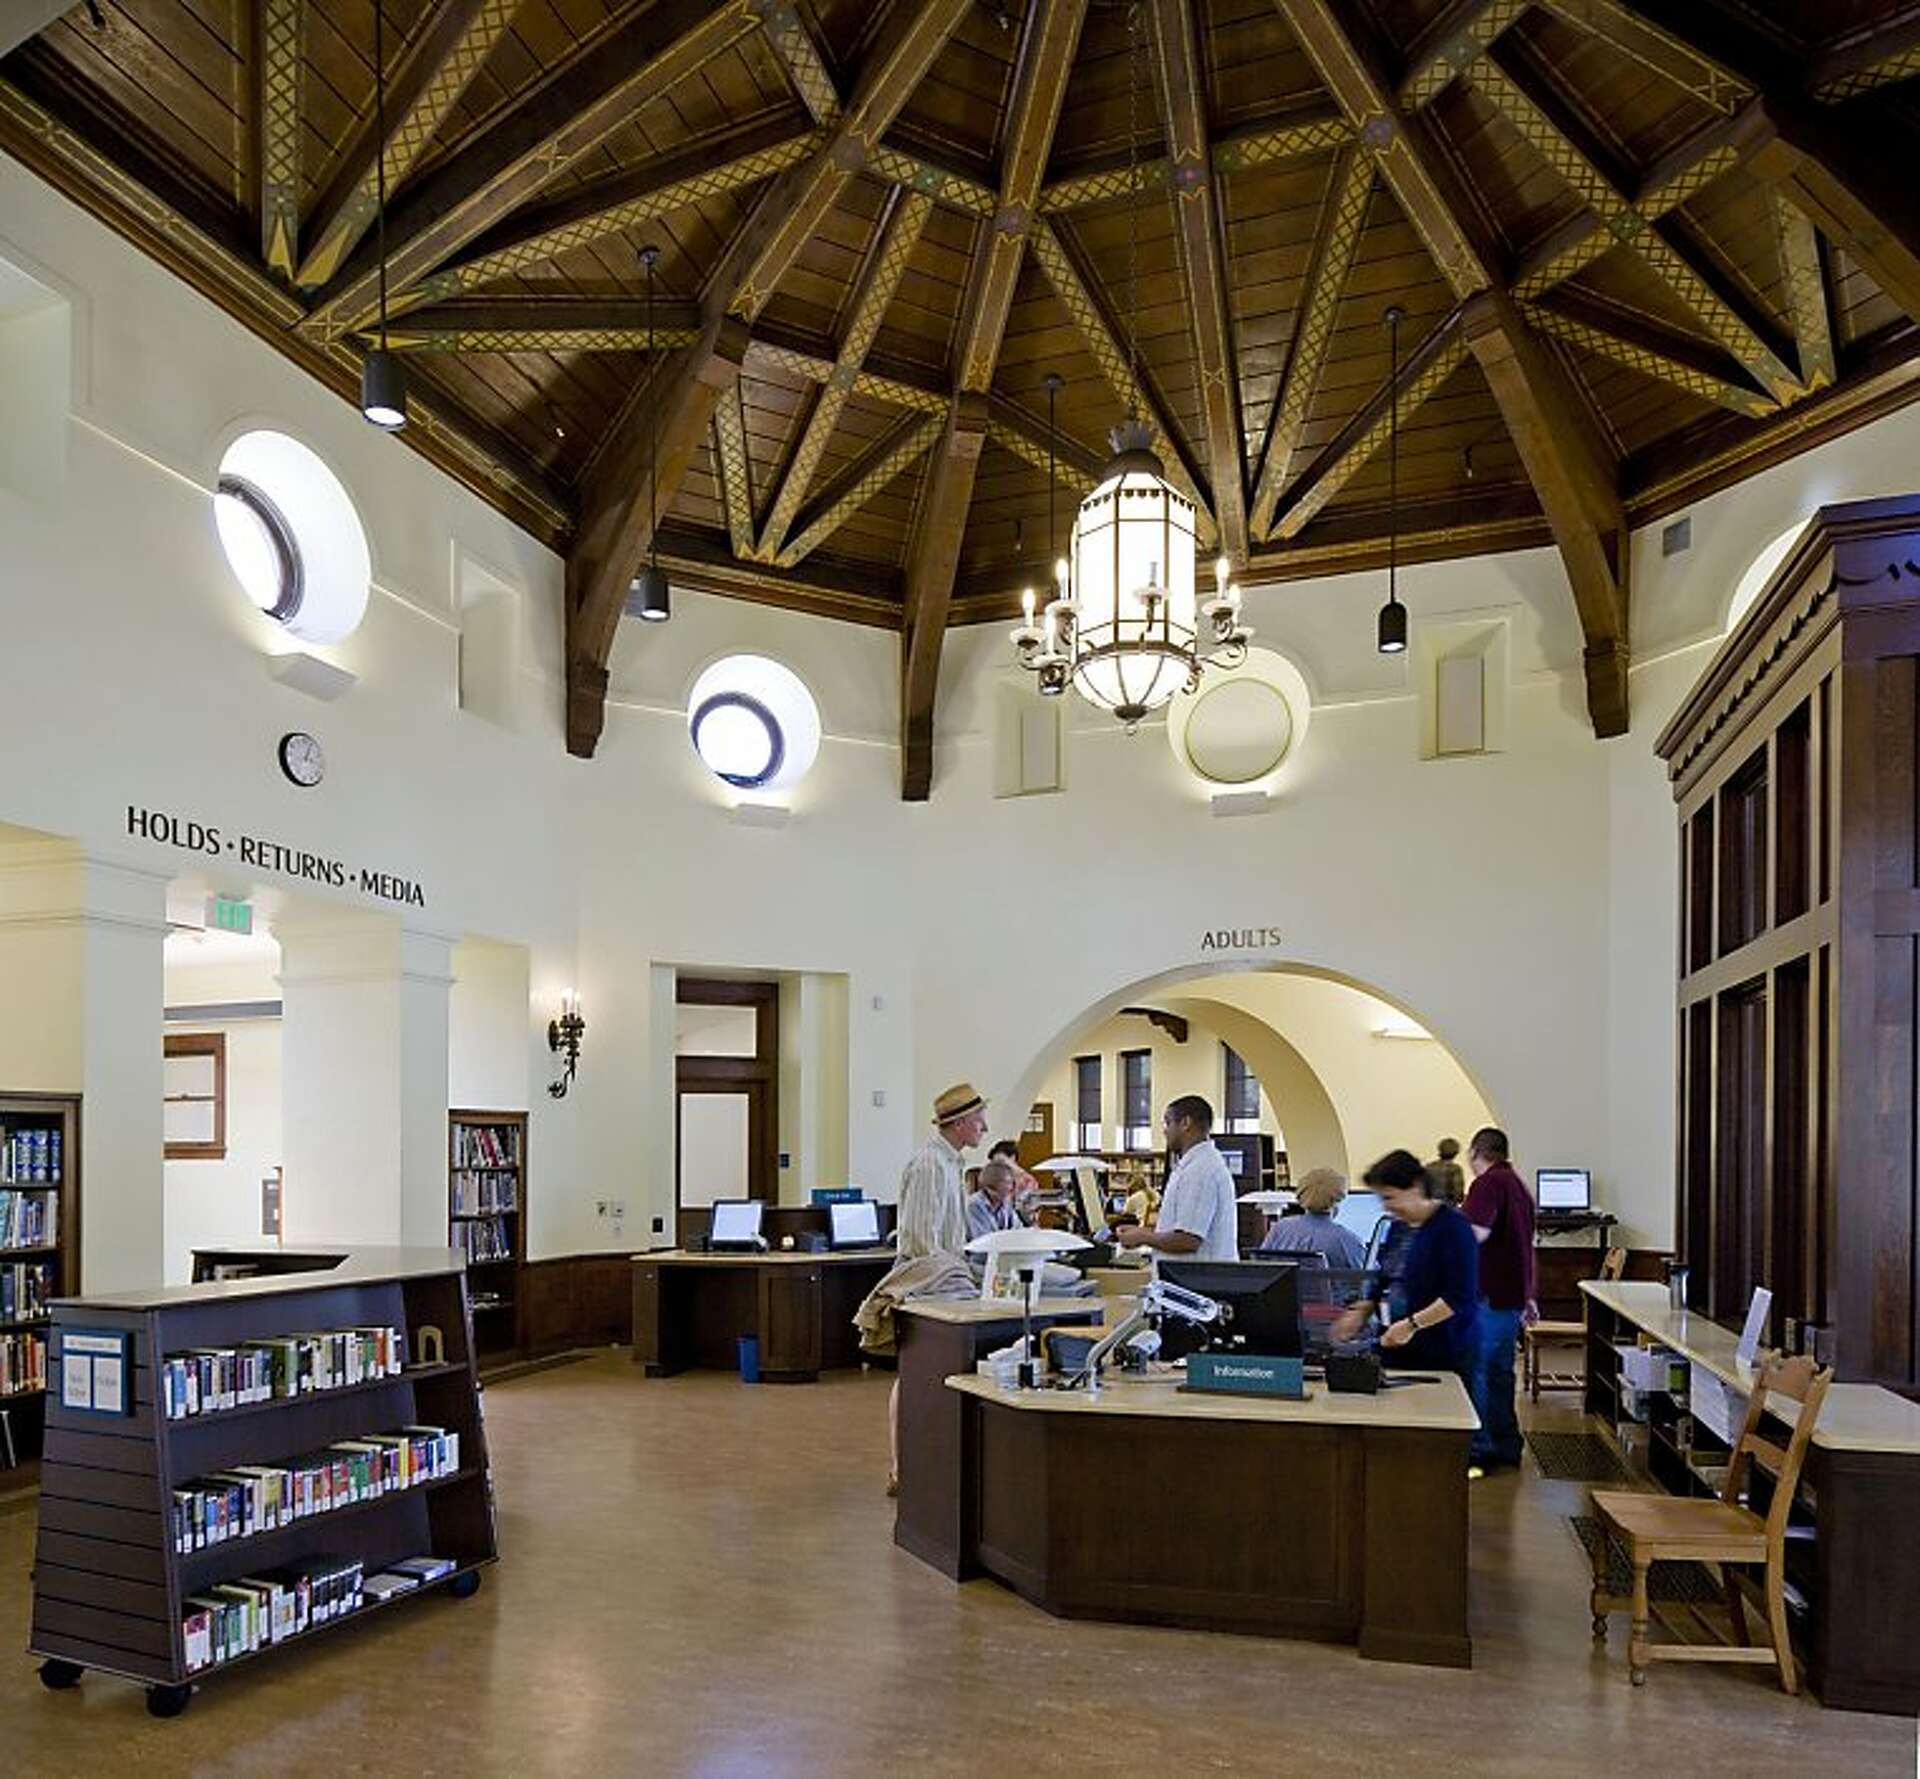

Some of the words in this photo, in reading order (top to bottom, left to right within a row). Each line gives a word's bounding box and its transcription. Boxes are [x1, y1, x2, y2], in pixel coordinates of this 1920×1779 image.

[127, 805, 221, 856] HOLDS
[240, 836, 345, 887] RETURNS
[360, 868, 425, 908] MEDIA
[1201, 927, 1282, 951] ADULTS
[1213, 1365, 1275, 1380] Information
